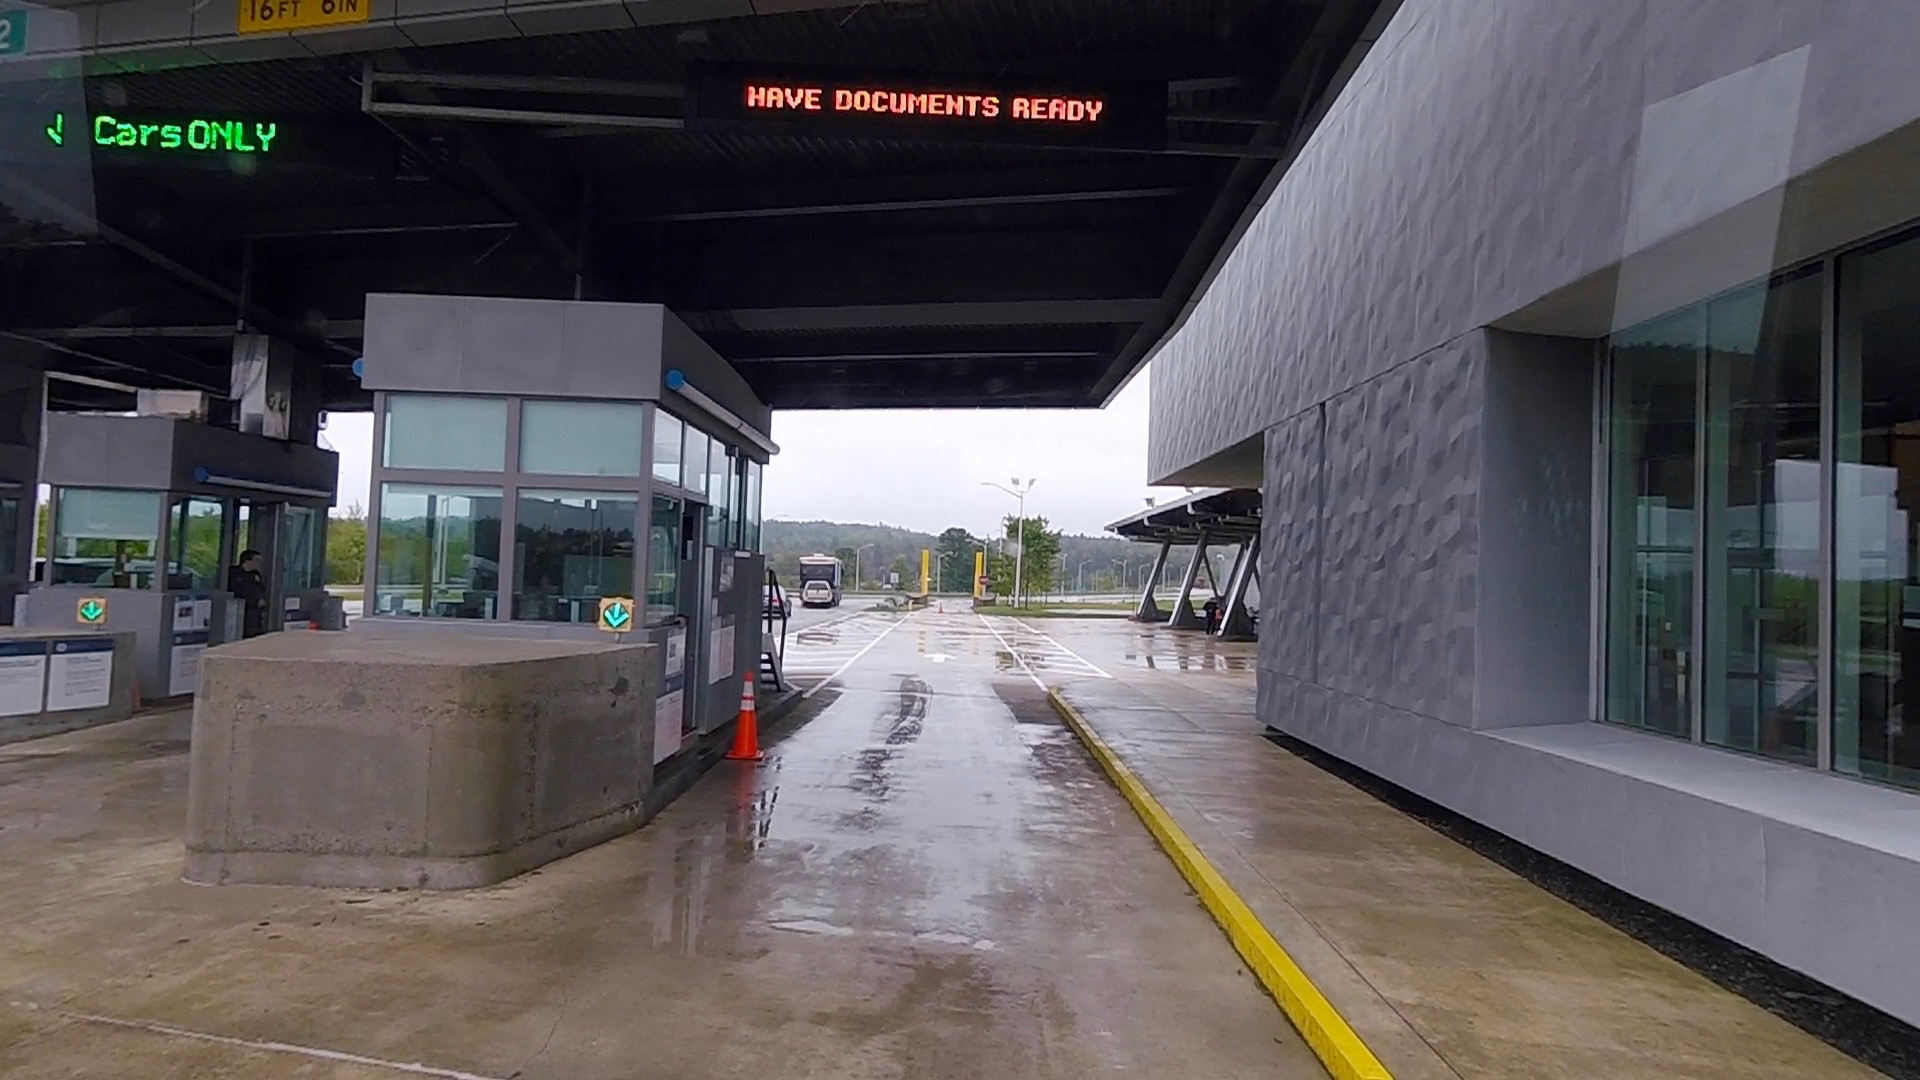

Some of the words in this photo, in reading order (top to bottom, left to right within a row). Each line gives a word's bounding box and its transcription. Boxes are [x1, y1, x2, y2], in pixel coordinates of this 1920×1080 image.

[747, 86, 823, 110] HAVE
[835, 89, 1000, 117] DOCUMENTS
[1012, 97, 1103, 121] READY
